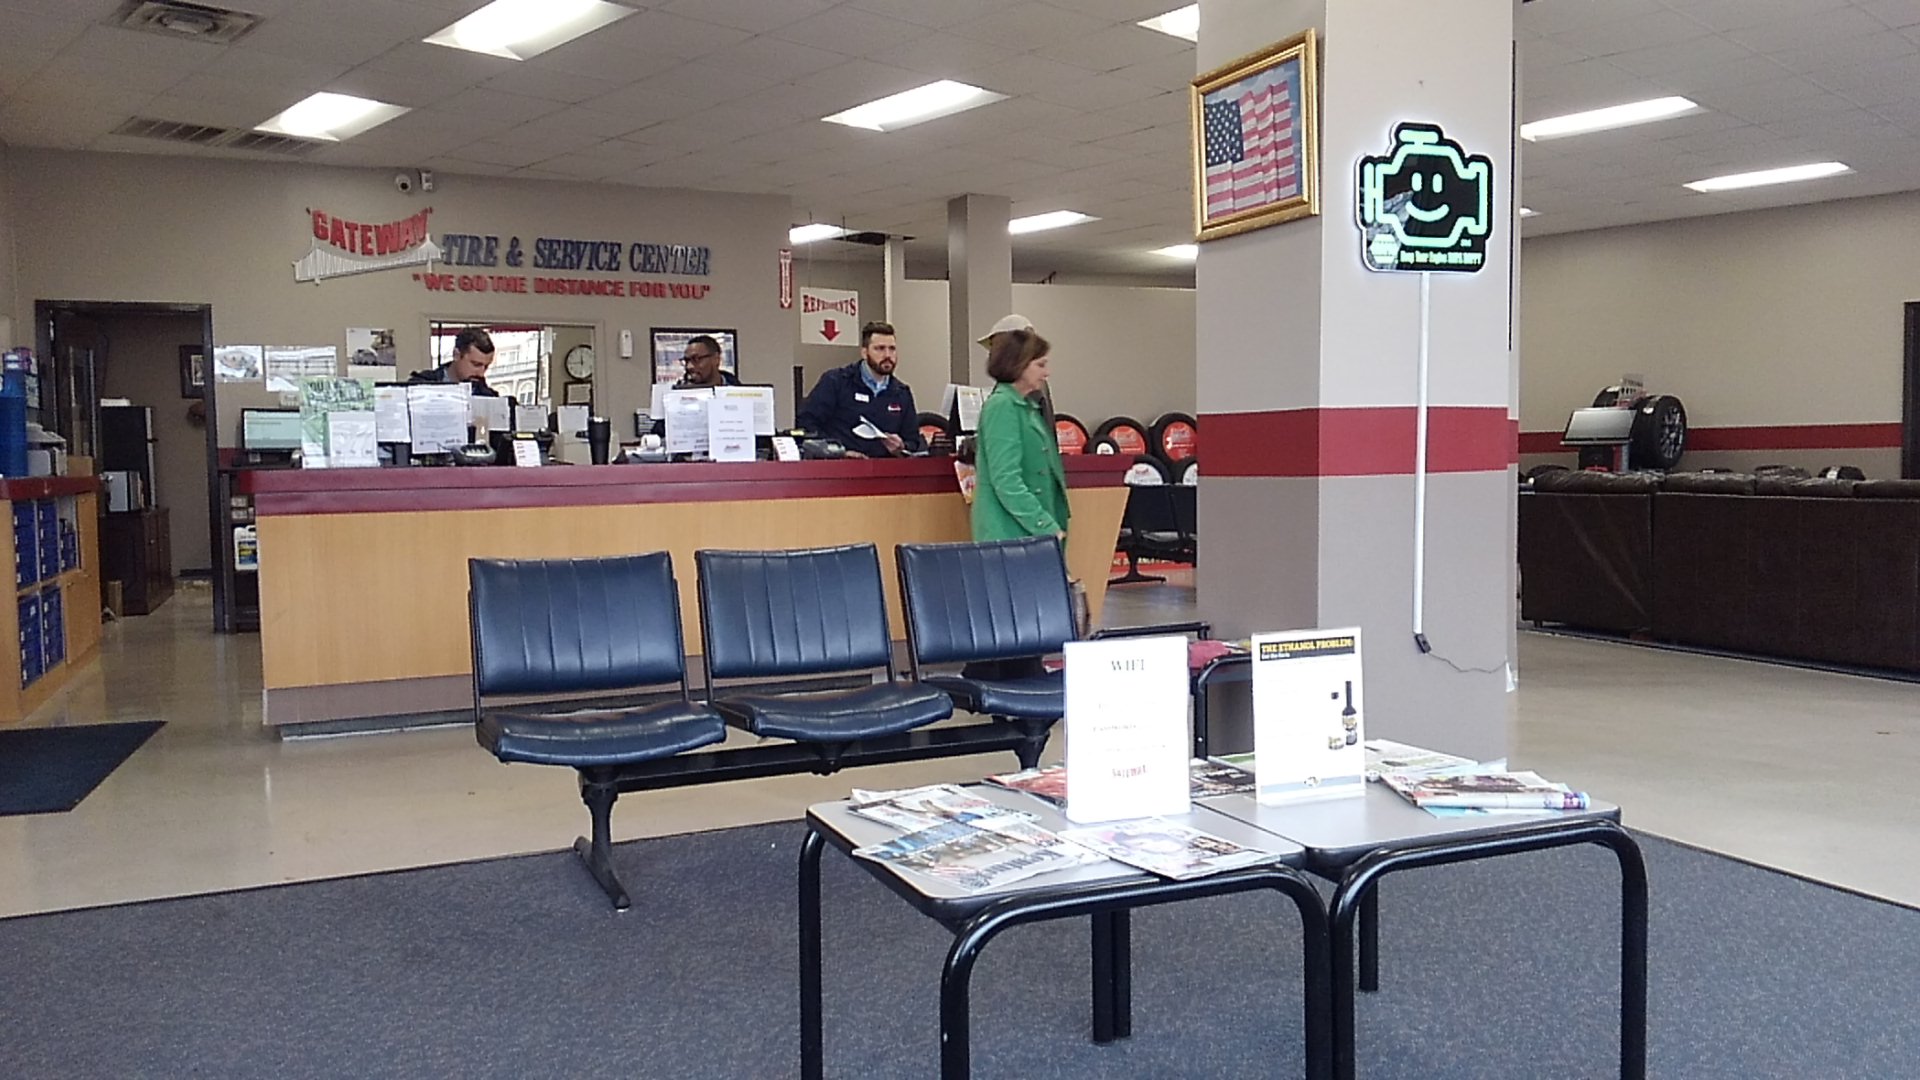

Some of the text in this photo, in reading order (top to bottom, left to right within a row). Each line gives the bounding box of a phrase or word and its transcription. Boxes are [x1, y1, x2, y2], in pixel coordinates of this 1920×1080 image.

[312, 208, 429, 256] GATEWAY
[442, 233, 710, 275] TIRE & SERVICE CENTER
[458, 275, 487, 292] GO
[488, 276, 528, 293] THE
[533, 277, 625, 297] DISTANCE
[629, 281, 667, 298] FOR
[668, 283, 710, 299] YOU"
[802, 294, 857, 316] REFRNTS
